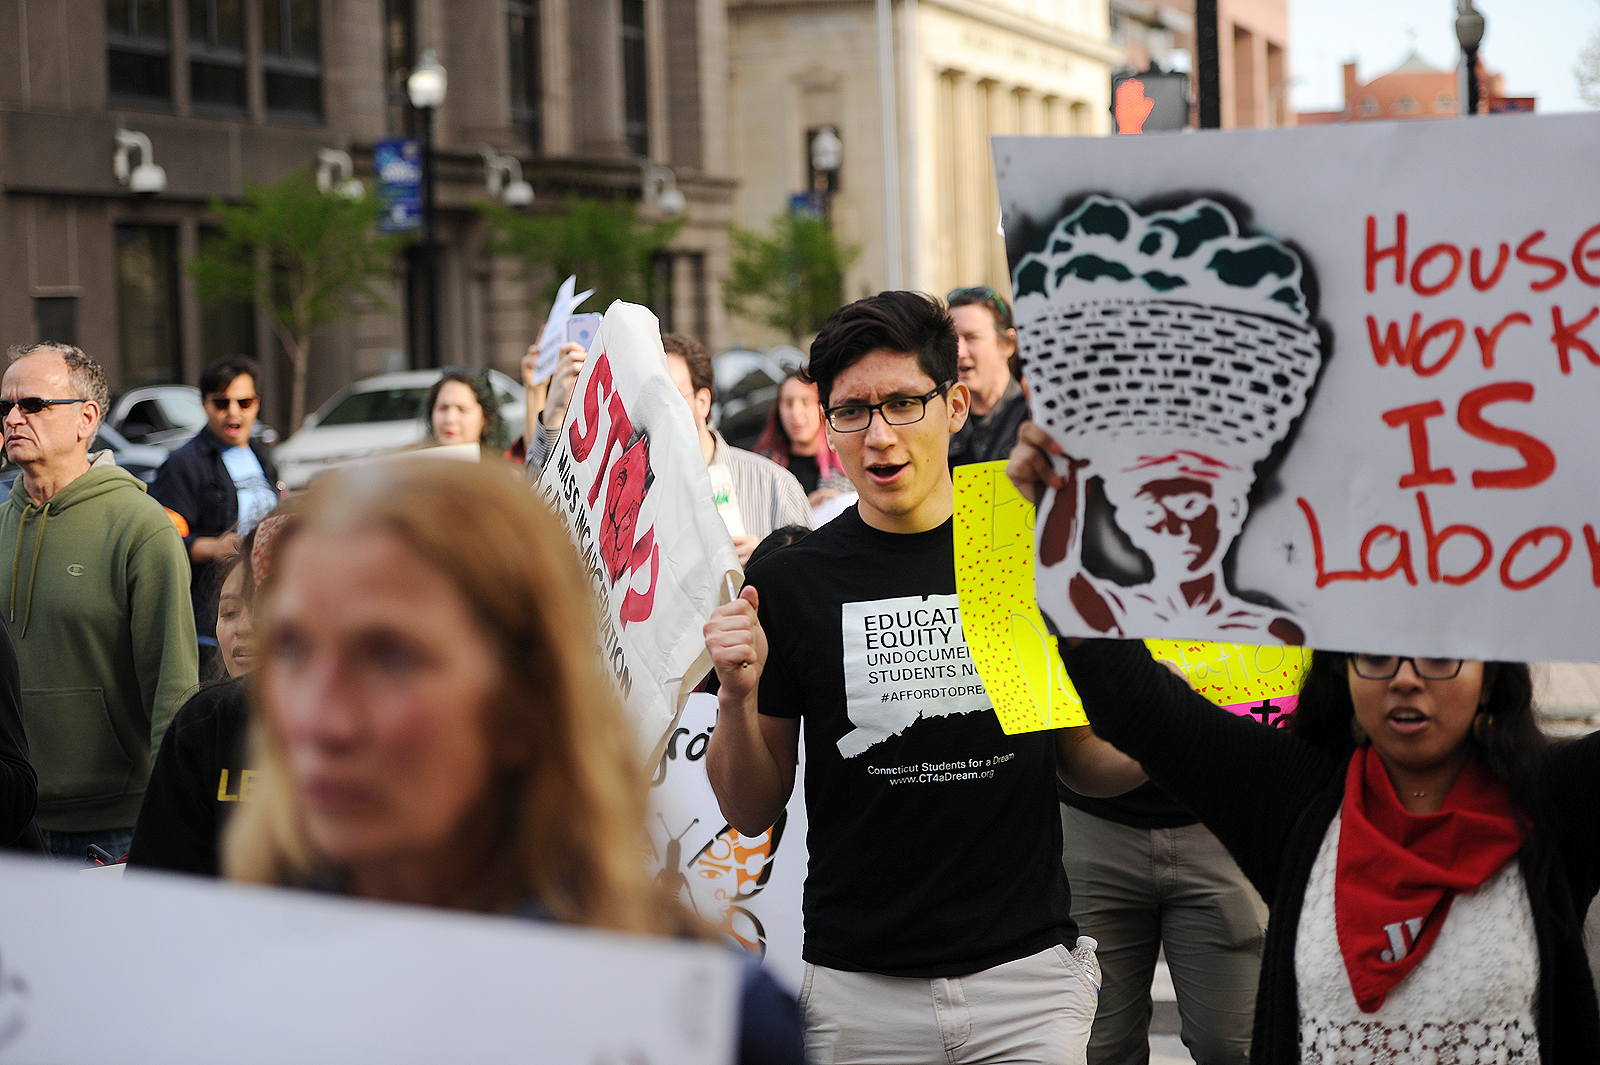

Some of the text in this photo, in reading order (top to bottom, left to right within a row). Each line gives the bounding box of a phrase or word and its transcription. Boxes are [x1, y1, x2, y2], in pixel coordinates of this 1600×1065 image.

[1382, 381, 1557, 490] IS
[865, 626, 952, 650] EQUITY
[868, 664, 957, 685] STUDENTS
[921, 760, 966, 772] Students
[968, 758, 983, 768] for
[992, 752, 1015, 766] Dream
[889, 769, 995, 786] www.CT4aDream.org
